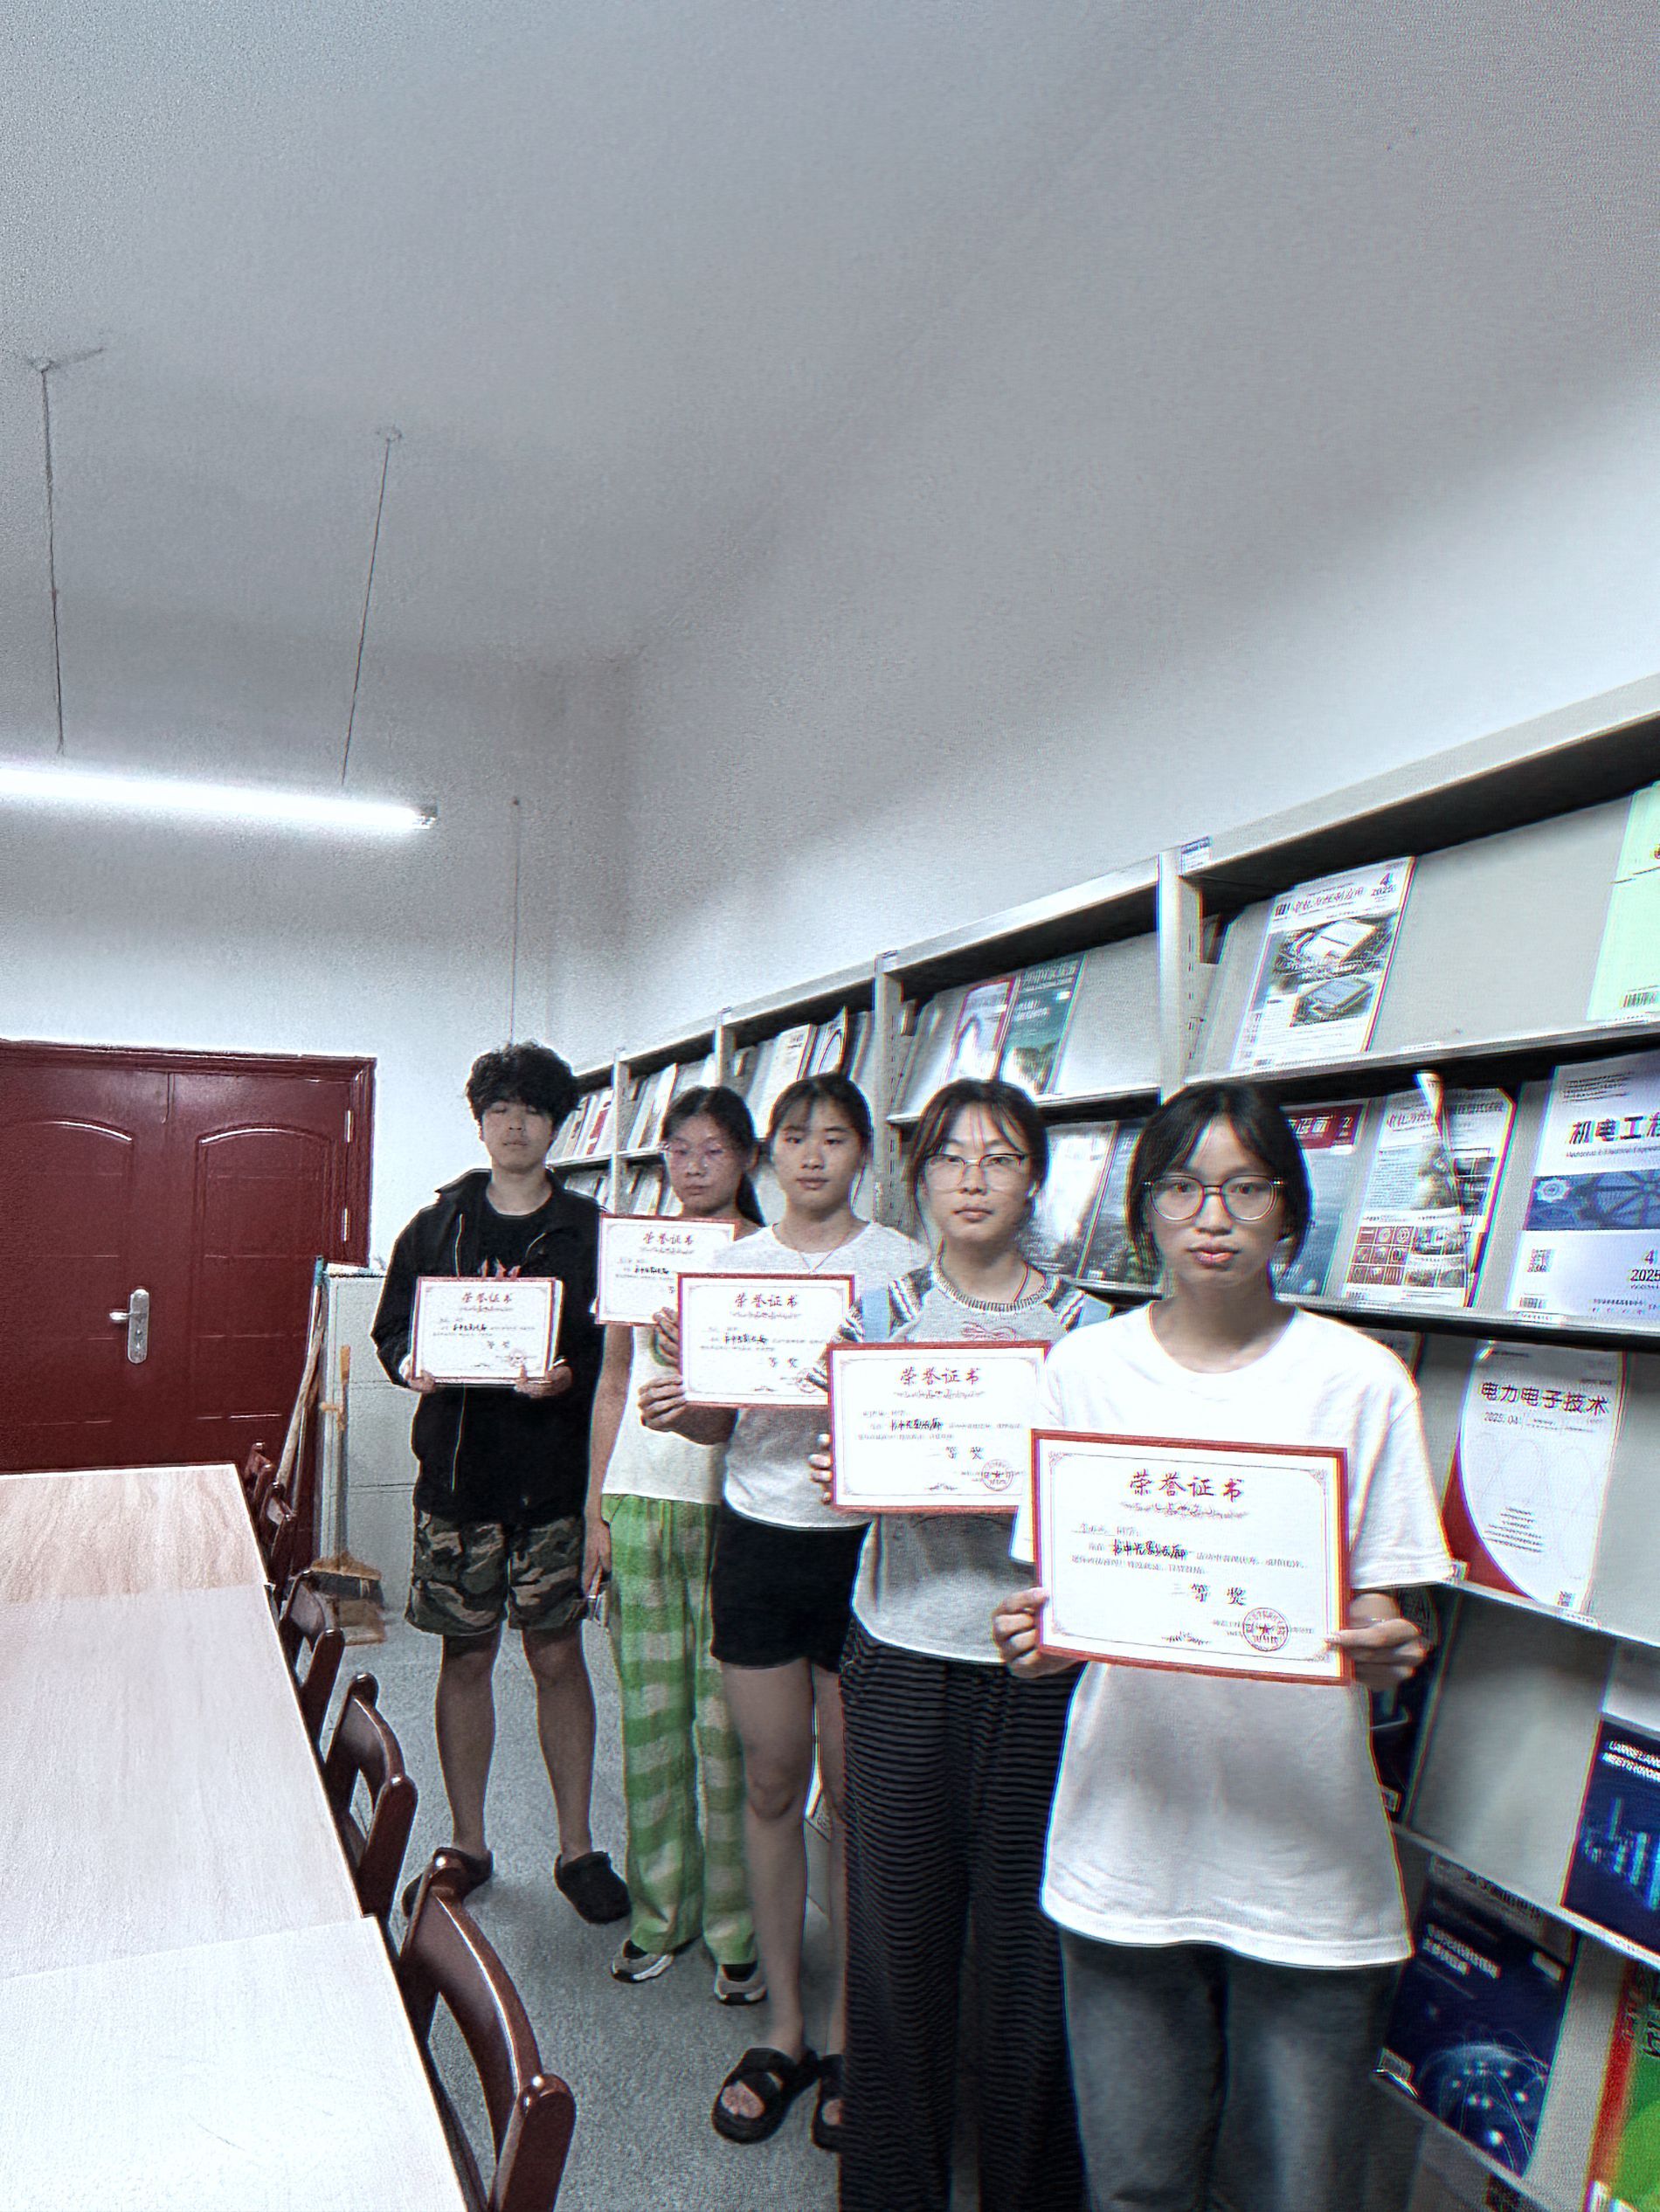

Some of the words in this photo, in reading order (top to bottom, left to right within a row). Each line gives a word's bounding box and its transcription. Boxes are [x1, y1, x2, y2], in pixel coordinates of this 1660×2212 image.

[1629, 1268, 1660, 1282] 2025
[735, 1292, 799, 1308] 荣誉证书
[900, 1366, 980, 1386] 荣誉证书
[1481, 1382, 1609, 1416] 电力电子技术
[1129, 1469, 1244, 1502] 荣誉证书
